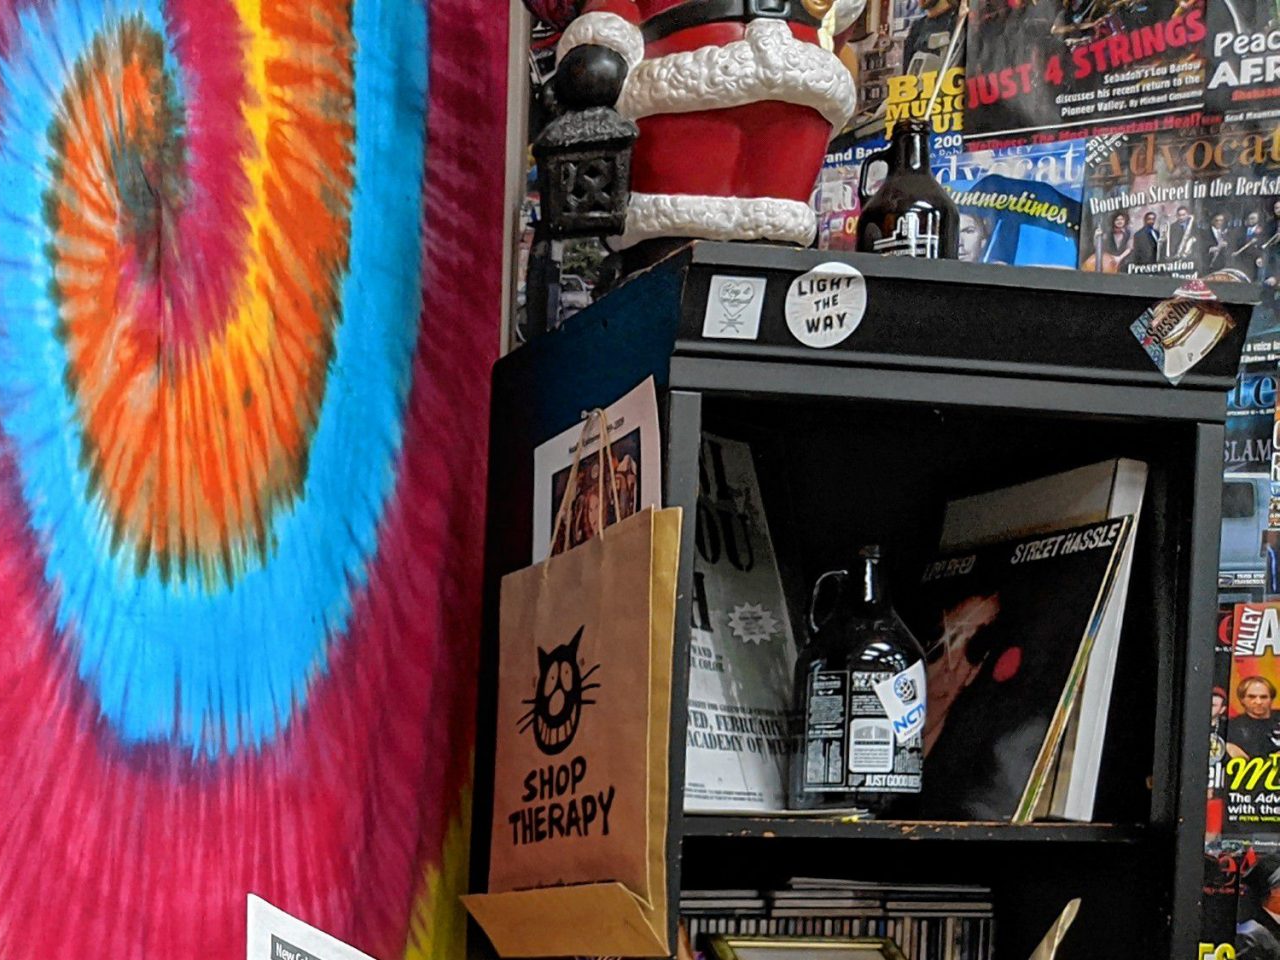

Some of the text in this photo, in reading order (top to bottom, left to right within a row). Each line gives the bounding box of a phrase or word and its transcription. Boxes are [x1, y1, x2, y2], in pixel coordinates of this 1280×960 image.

[967, 10, 1207, 109] JUST 4 STRINGS
[1151, 66, 1168, 77] Lou
[1170, 61, 1201, 74] Barlow
[1055, 74, 1200, 104] discusses his recent return to the
[1061, 104, 1096, 117] Pioneer
[1097, 98, 1127, 112] Valley.
[1089, 190, 1146, 216] Bourbon
[1148, 180, 1190, 204] Street
[1193, 181, 1208, 198] in
[1209, 178, 1233, 197] the
[1127, 260, 1195, 275] Preservation
[797, 275, 857, 297] LIGHT
[814, 294, 839, 312] THE
[805, 312, 848, 334] WAY
[1010, 523, 1121, 565] STREET HASSLE
[1234, 606, 1262, 656] VALLEY
[715, 713, 781, 737] FEBRUARY
[688, 730, 765, 755] ACADEMY OF
[521, 755, 587, 803] SHOP
[865, 774, 887, 787] JUST
[1227, 803, 1256, 815] with
[1229, 792, 1252, 803] The
[508, 784, 616, 847] THERAPY
